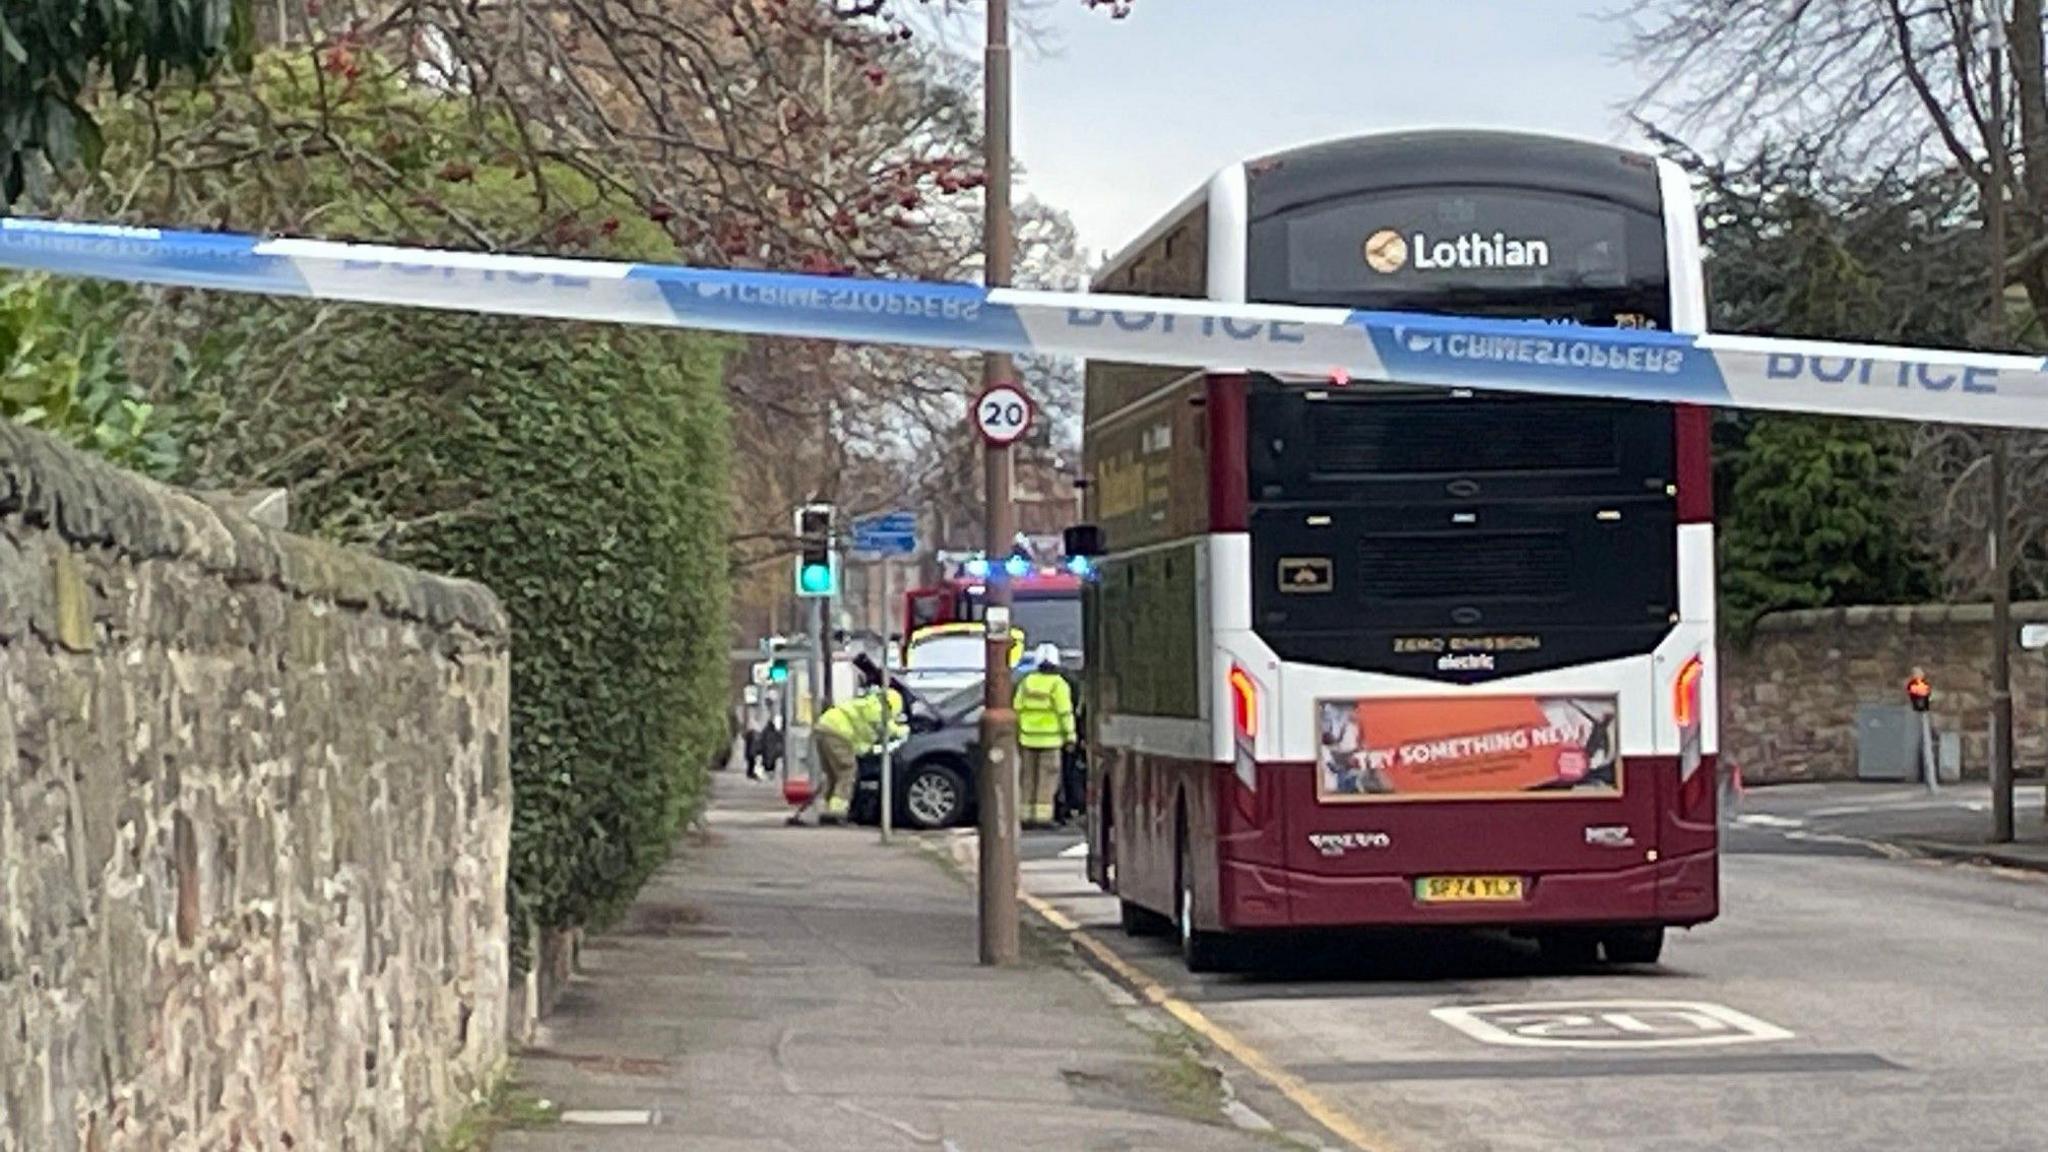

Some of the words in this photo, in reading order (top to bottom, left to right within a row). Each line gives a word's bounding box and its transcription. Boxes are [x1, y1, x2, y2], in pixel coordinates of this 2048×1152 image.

[1413, 232, 1549, 268] Lothian
[984, 402, 1023, 426] 20
[1355, 747, 1396, 771] TRY
[1401, 729, 1529, 765] SOMETHING
